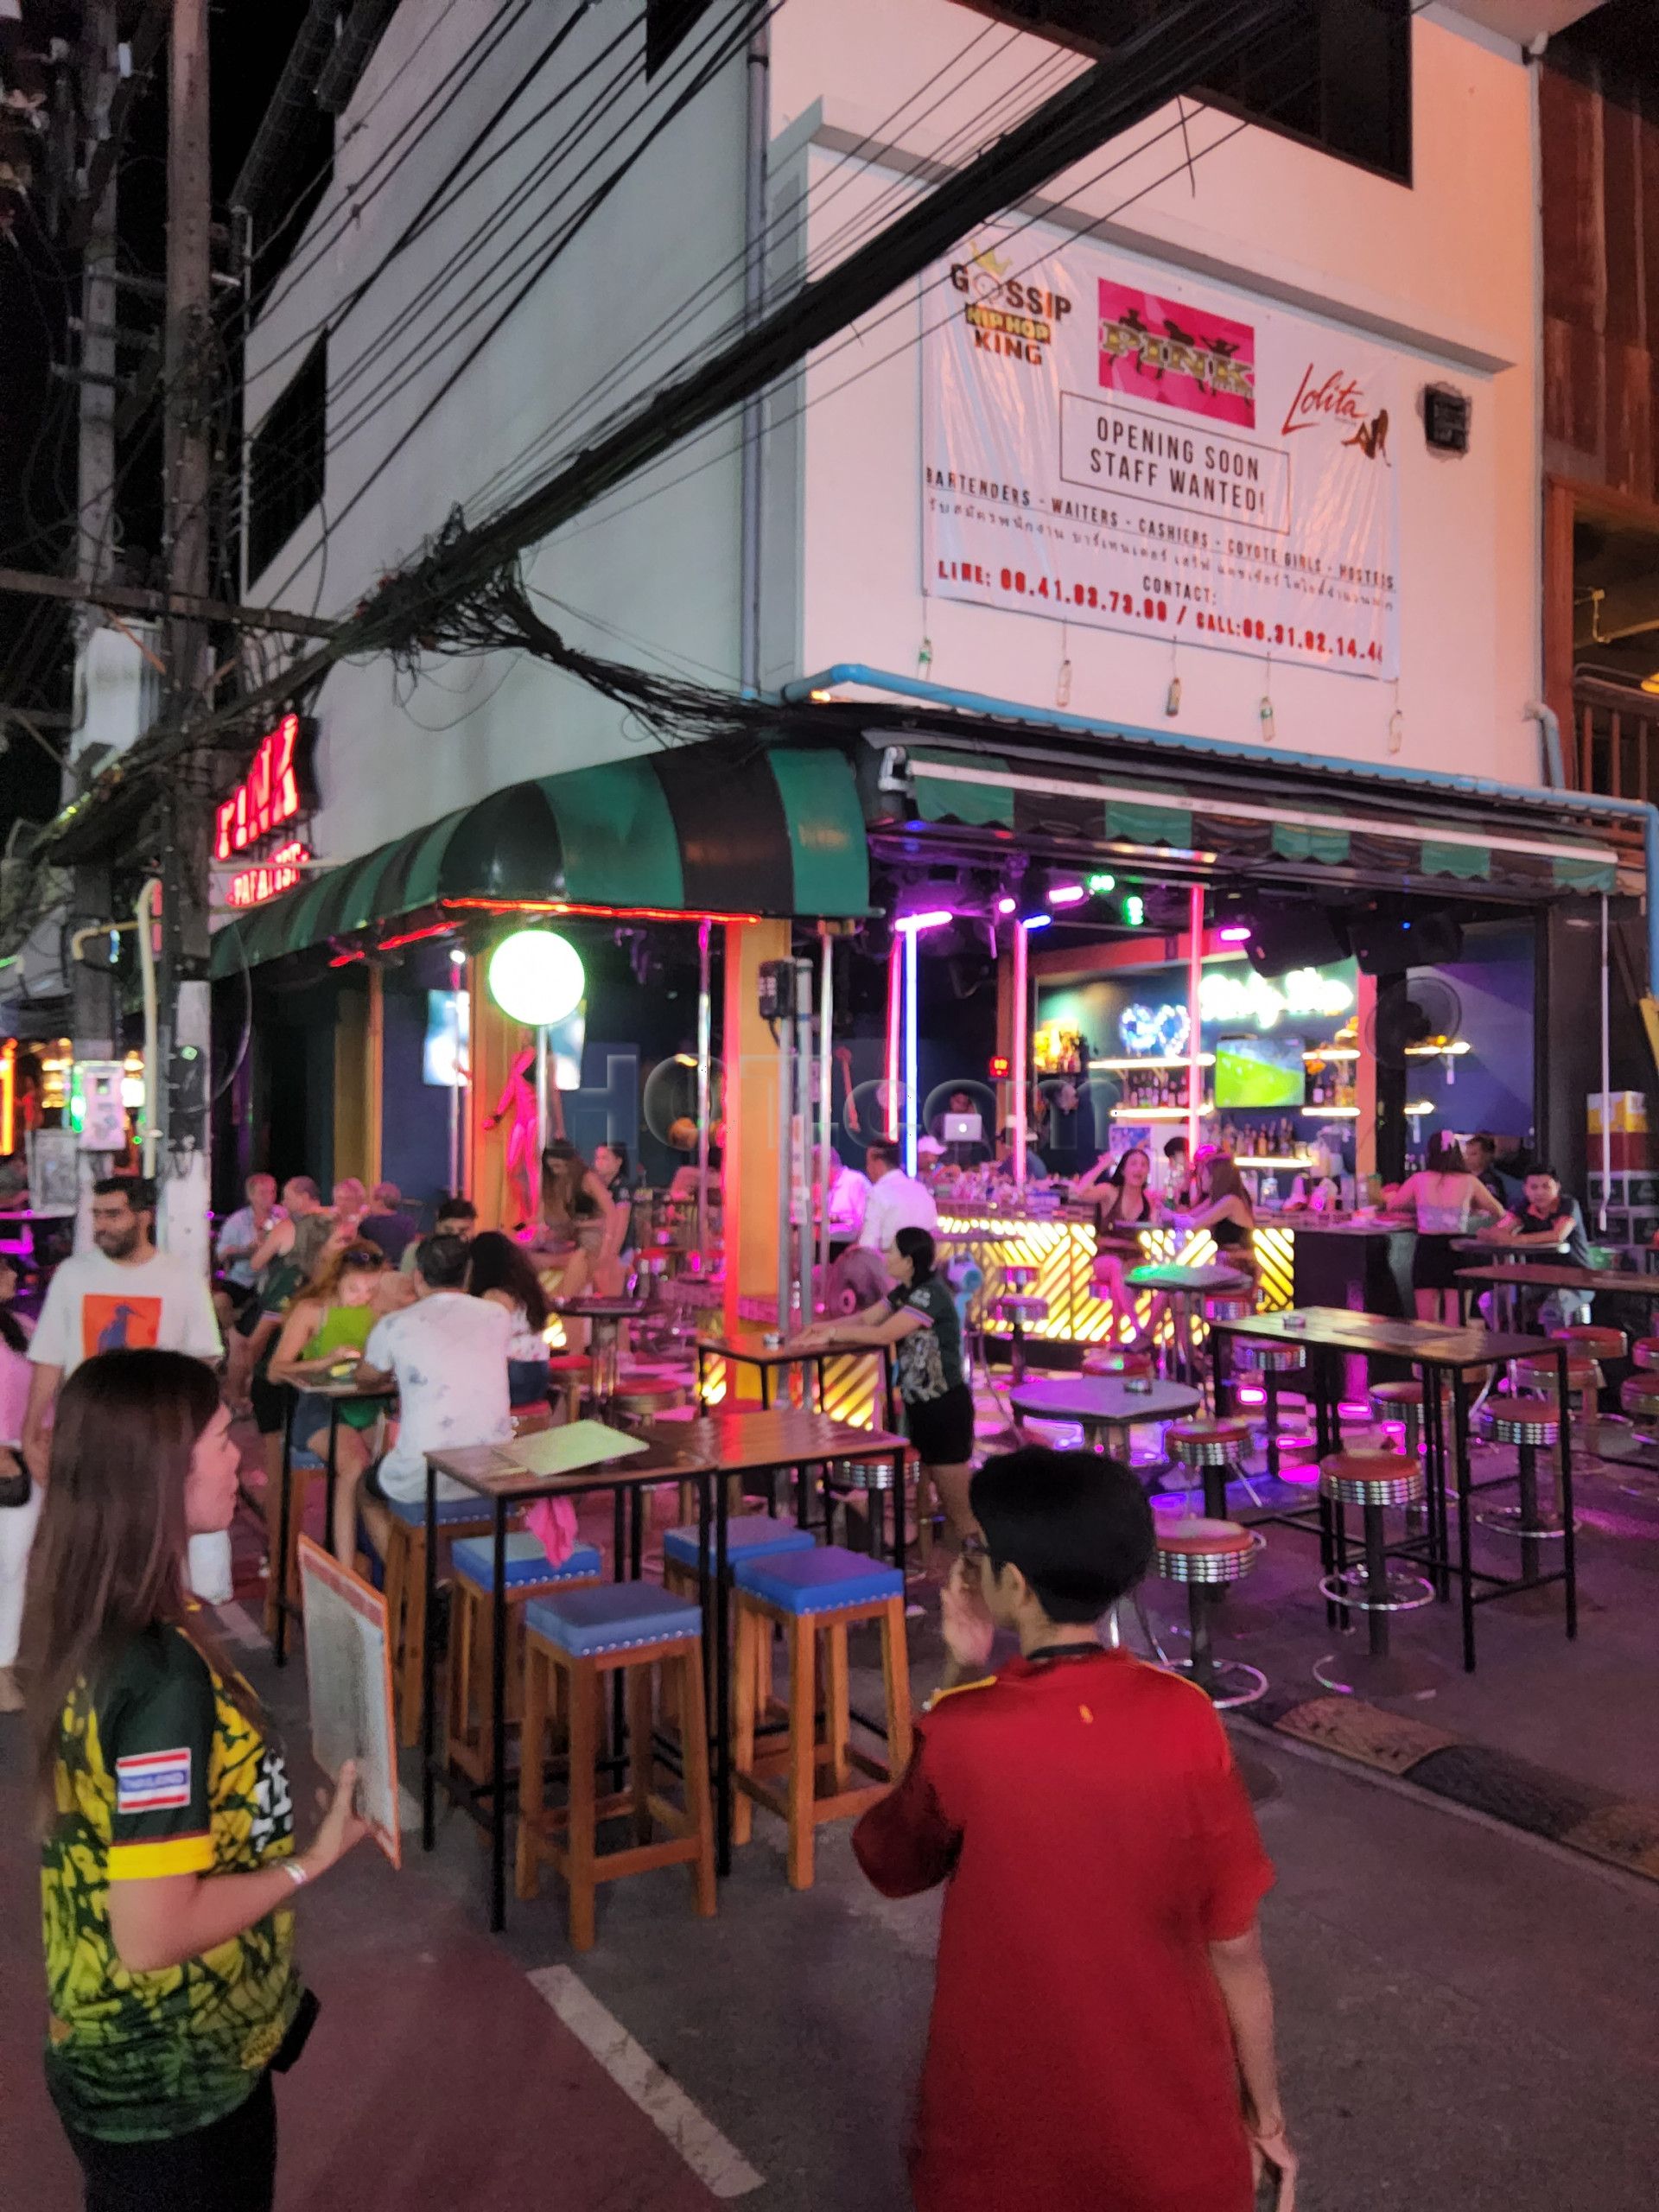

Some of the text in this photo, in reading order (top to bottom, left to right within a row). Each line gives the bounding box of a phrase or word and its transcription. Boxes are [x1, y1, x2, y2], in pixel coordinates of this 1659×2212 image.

[950, 263, 1071, 321] GOSSIP
[975, 329, 1042, 365] KING
[1102, 321, 1254, 397] PINK
[1281, 363, 1369, 435] Lolita
[1090, 448, 1265, 513] STAFF WANTED!
[1096, 416, 1259, 481] OPENING SOON
[926, 467, 1030, 506] BARTENDERS
[1051, 497, 1118, 528] WAITERS
[1139, 518, 1209, 549] CASHIERS
[1228, 538, 1277, 563] COYOTE
[938, 560, 991, 588] LINE:
[1142, 575, 1217, 606] CONTACT:
